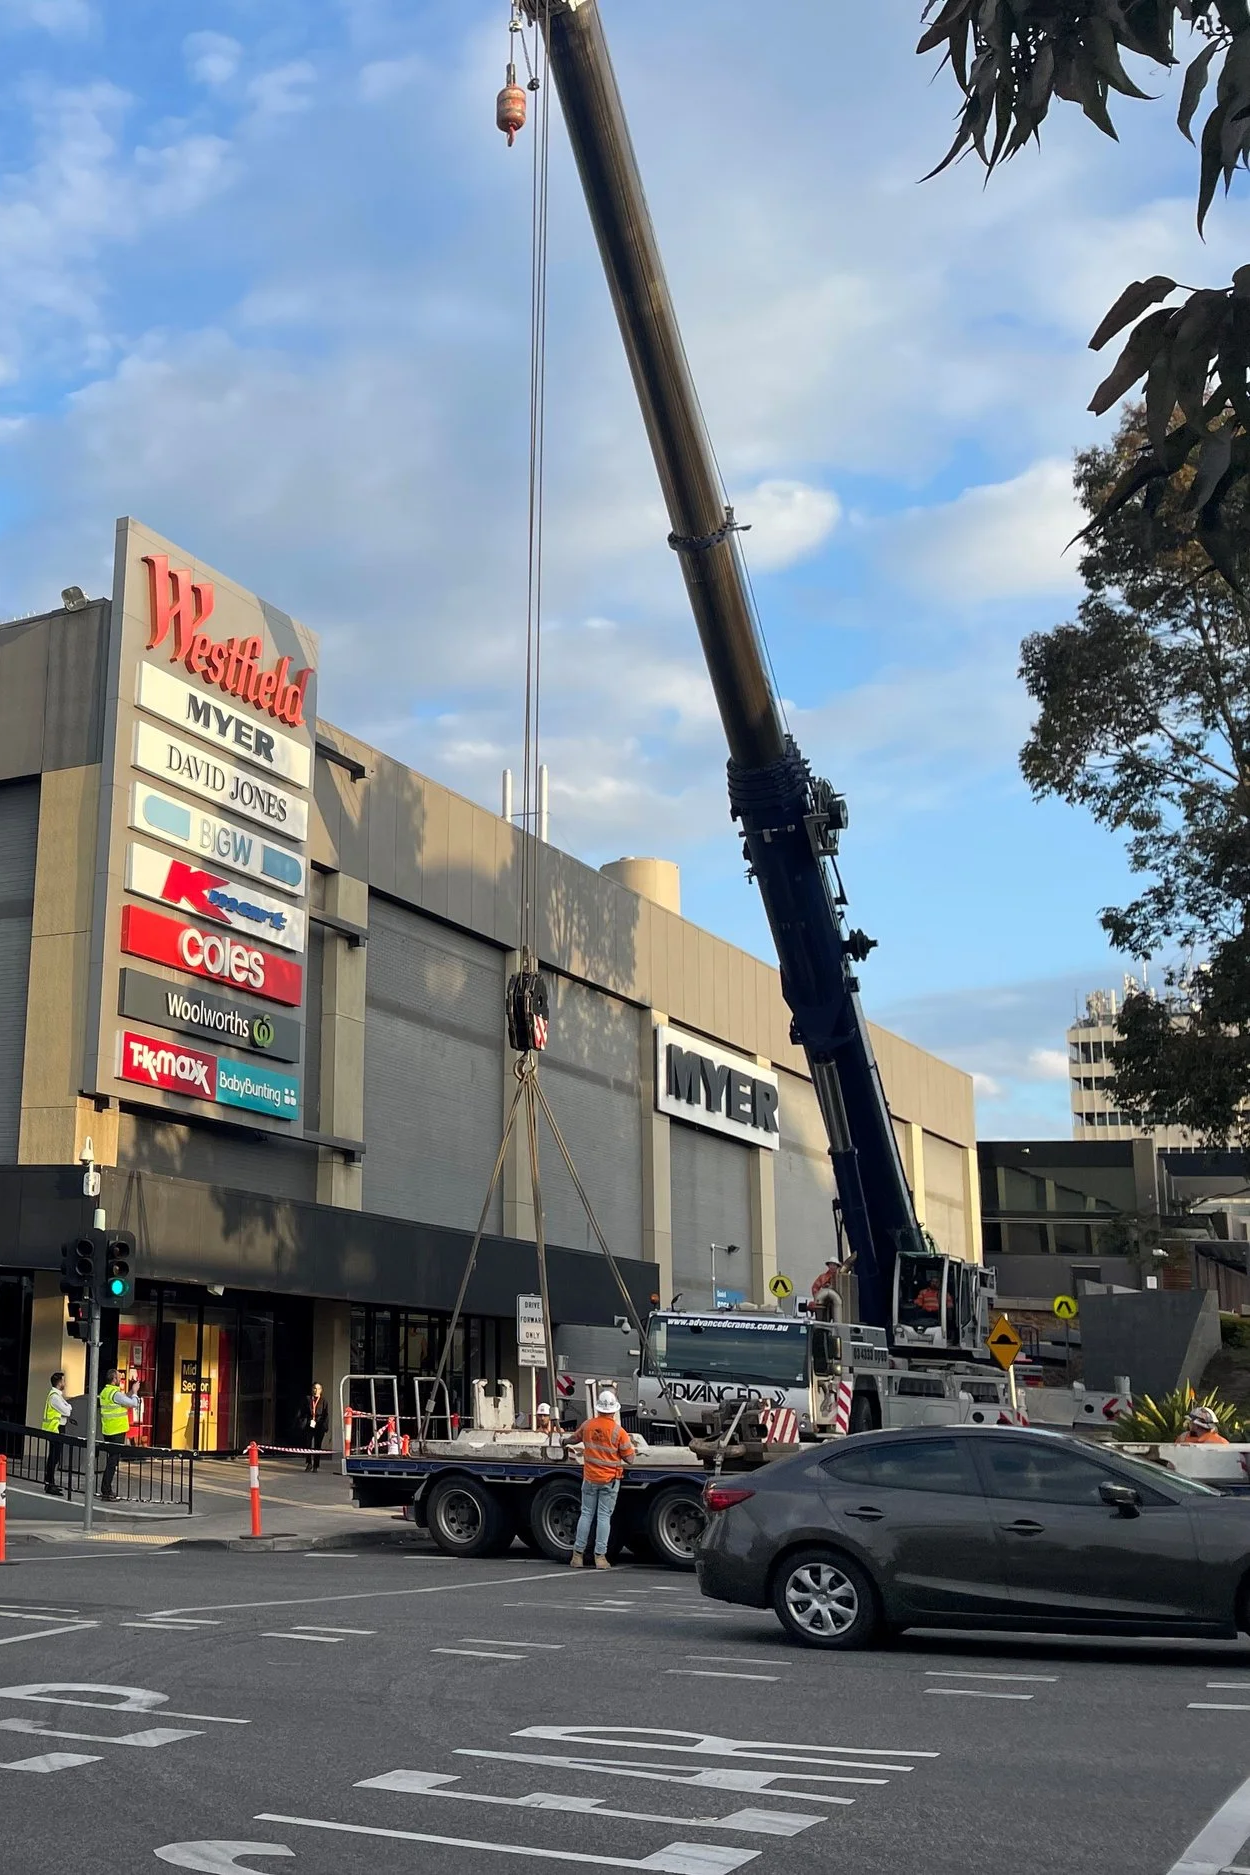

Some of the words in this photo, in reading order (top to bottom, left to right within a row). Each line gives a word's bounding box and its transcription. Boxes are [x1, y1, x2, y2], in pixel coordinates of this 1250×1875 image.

[141, 554, 315, 728] Westfield
[186, 692, 275, 763] MYER
[166, 744, 226, 792] DAVID
[230, 776, 287, 821] JONES
[161, 859, 288, 925] Kmart
[178, 928, 265, 989] coles
[166, 991, 249, 1038] Woolworths
[666, 1043, 780, 1133] MYER
[520, 1315, 543, 1324] FORWAR
[524, 1301, 540, 1309] DRIVE
[667, 1318, 789, 1332] www.advancedcranes.com.au
[525, 1331, 540, 1340] ONLY
[182, 1363, 197, 1376] Mid
[657, 1382, 763, 1404] ADVANCED
